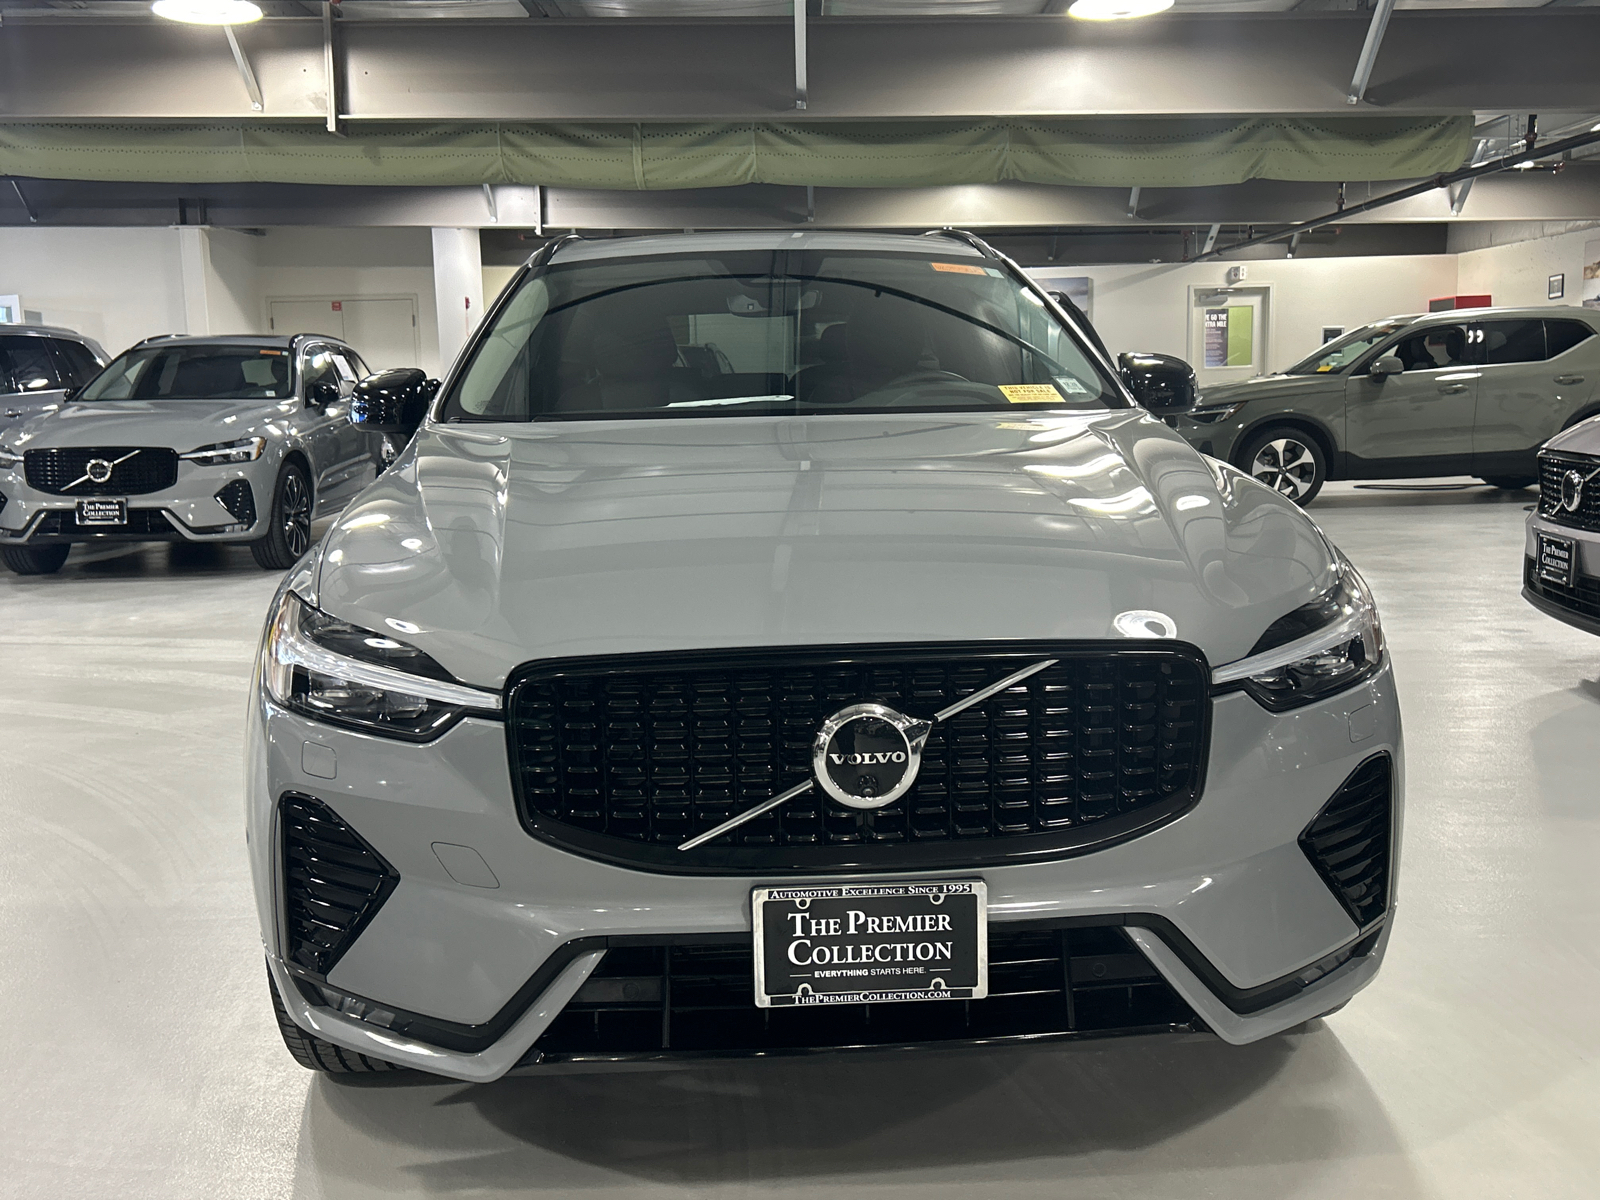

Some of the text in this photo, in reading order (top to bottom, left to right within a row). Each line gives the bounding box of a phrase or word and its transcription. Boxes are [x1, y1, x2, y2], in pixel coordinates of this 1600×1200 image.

[1551, 545, 1568, 559] PREMIER
[1542, 553, 1568, 570] COLLECTION
[829, 751, 906, 765] VOLVO
[770, 884, 970, 899] AUTOMOTIVE EXCELLENCE SINCE 1995
[787, 910, 953, 937] THE PREMIER
[787, 939, 953, 965] COLLECTION
[814, 969, 869, 978] EVERYTHING
[792, 991, 951, 1004] THEPREMIERCOLLECTION.COM
